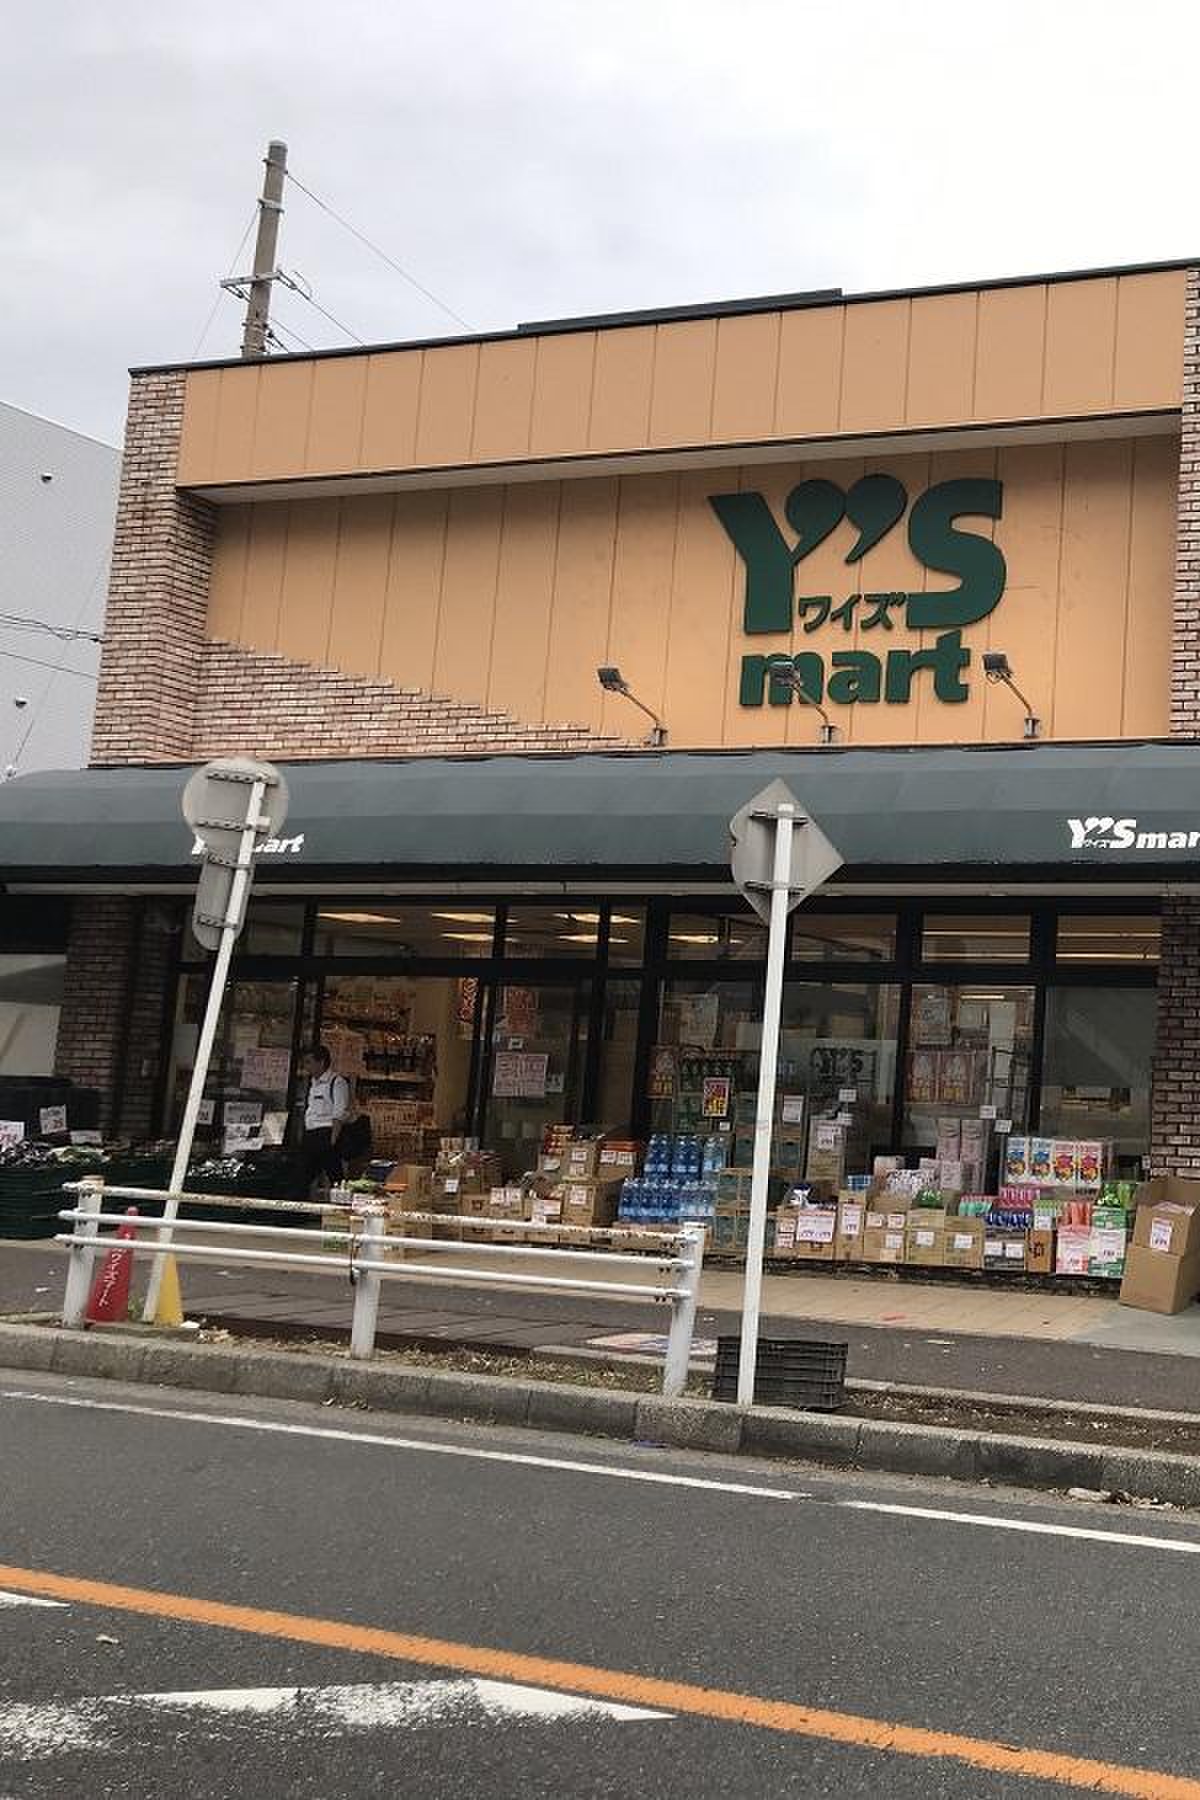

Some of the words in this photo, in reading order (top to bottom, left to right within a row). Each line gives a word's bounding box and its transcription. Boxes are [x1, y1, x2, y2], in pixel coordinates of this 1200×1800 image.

[798, 591, 907, 634] ワイズ
[739, 629, 971, 706] mart
[255, 833, 305, 853] art
